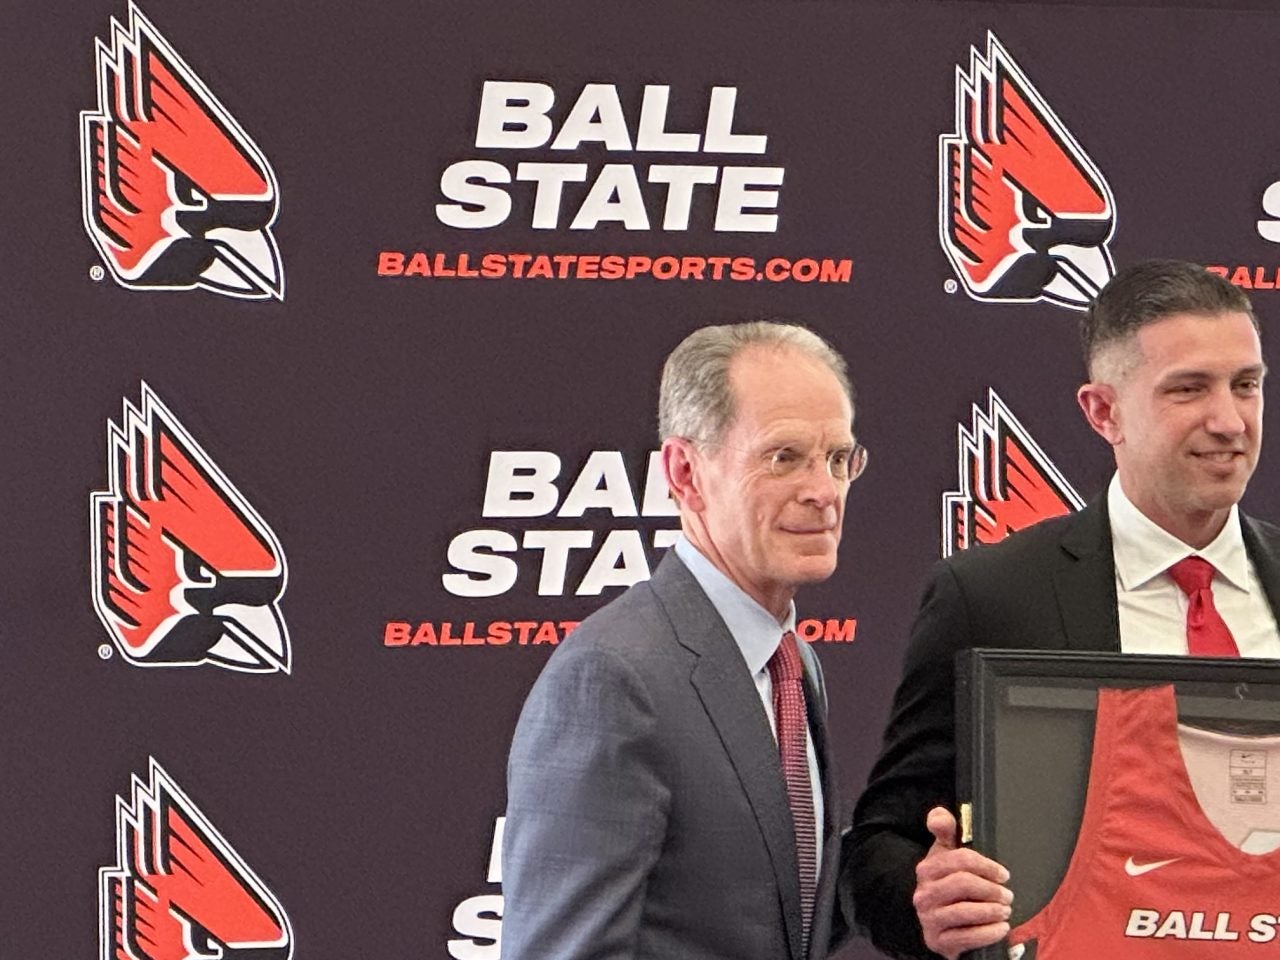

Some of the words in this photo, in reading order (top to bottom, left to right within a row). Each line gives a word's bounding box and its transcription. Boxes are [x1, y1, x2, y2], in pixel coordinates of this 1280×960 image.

[475, 80, 768, 154] BALL
[435, 160, 785, 233] STATE
[377, 251, 853, 284] BALLSTATESPORTS.COM
[482, 450, 682, 518] BAL
[442, 529, 683, 598] STA
[1124, 908, 1239, 941] BALL
